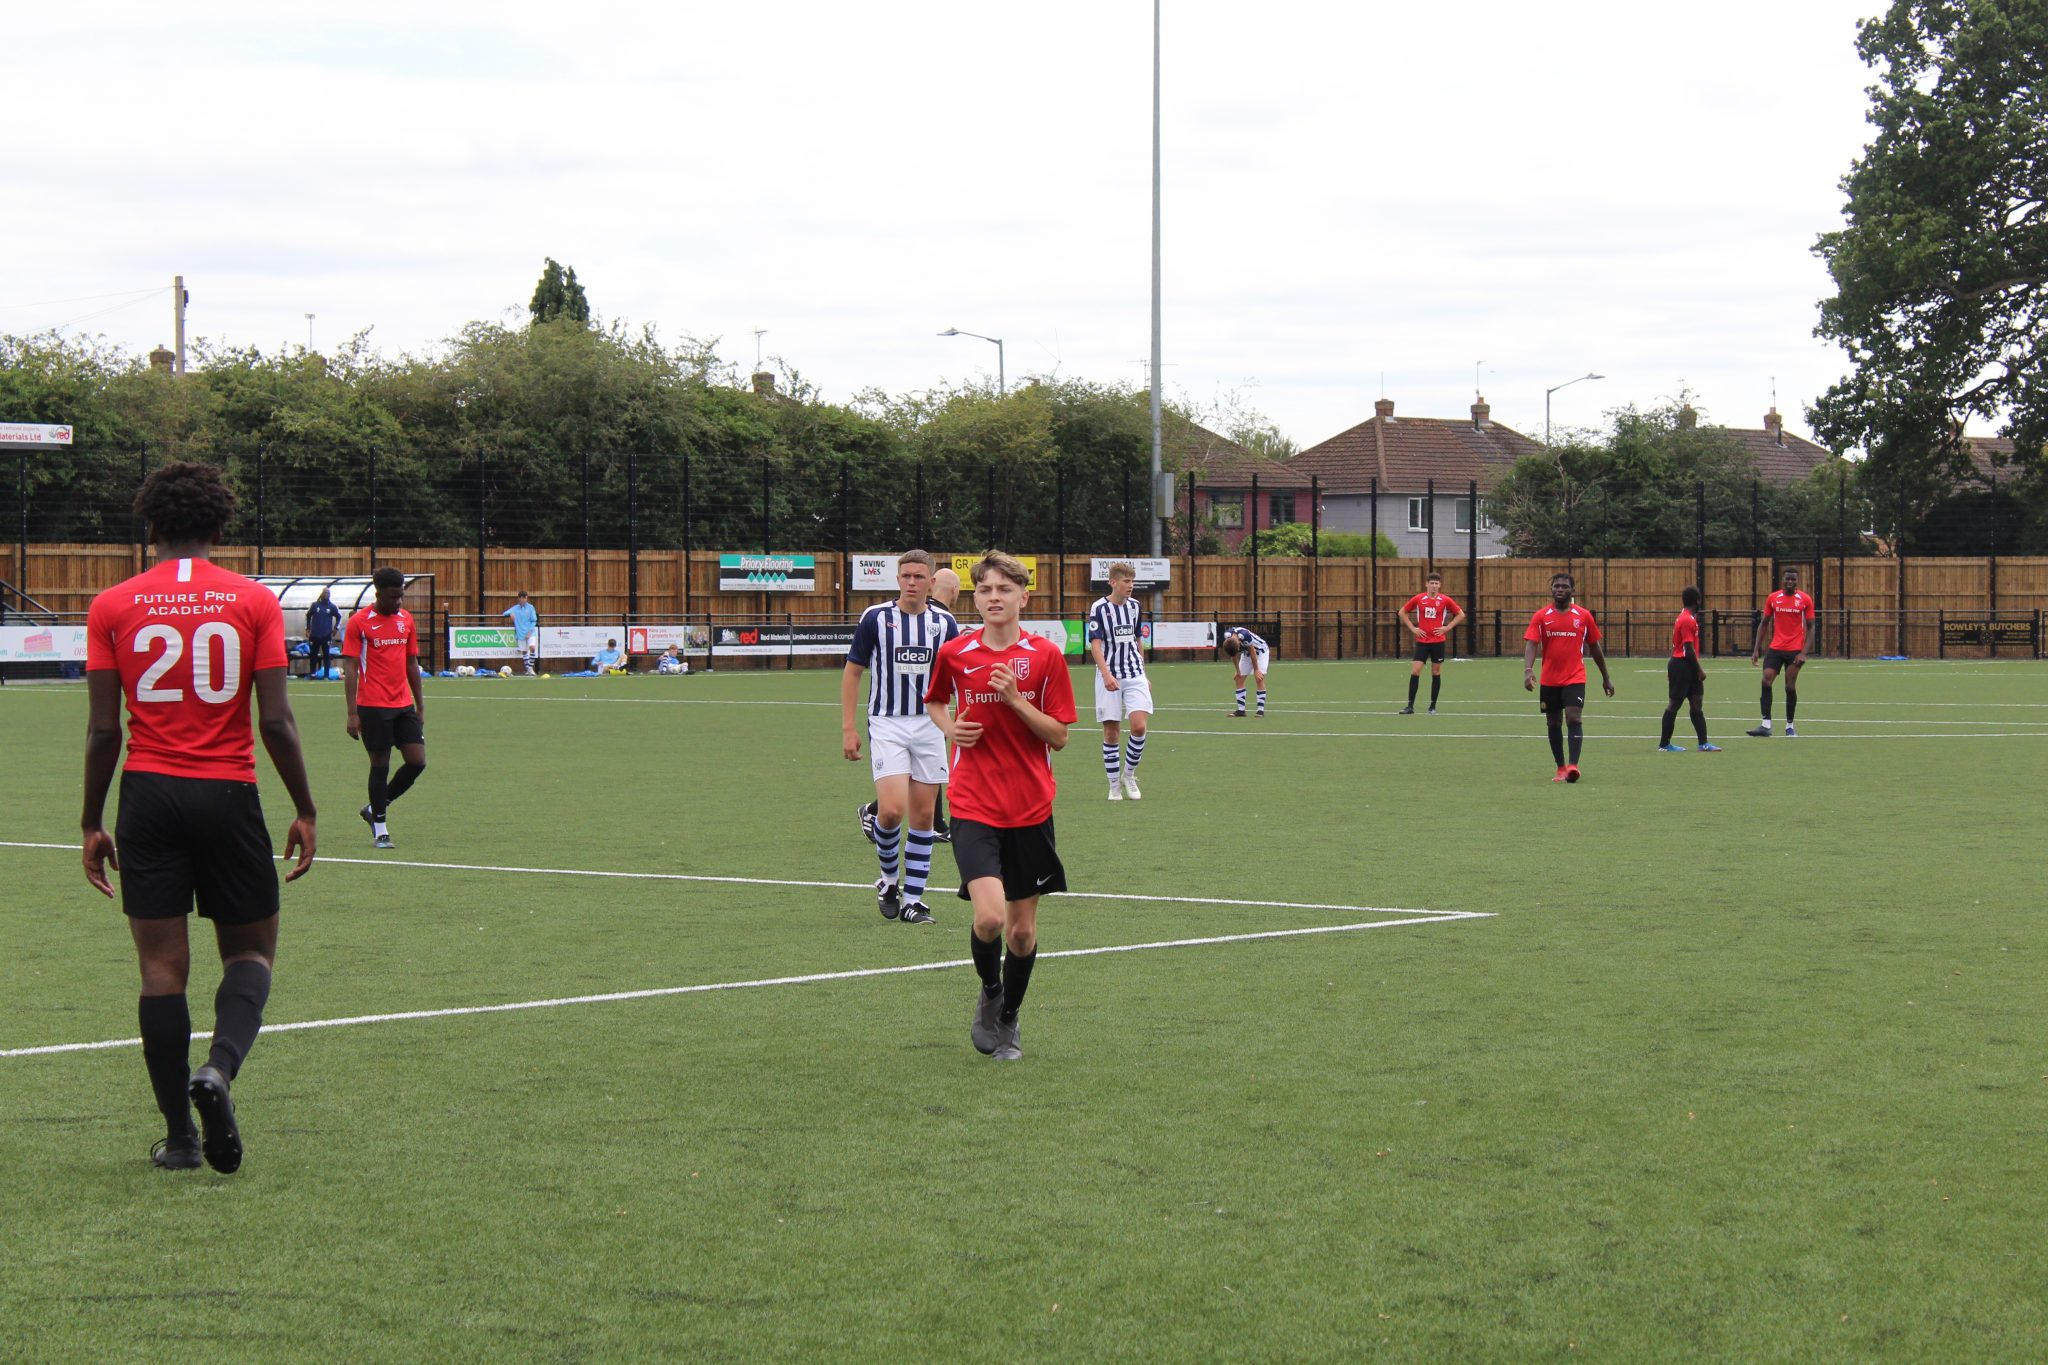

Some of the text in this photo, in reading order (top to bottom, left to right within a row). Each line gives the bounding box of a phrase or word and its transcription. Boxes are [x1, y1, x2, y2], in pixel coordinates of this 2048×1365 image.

[741, 557, 793, 572] Priory Flooring
[859, 560, 886, 568] SAVING
[955, 559, 969, 570] GR
[863, 568, 881, 576] LIVES
[134, 593, 198, 605] FUTURE
[147, 604, 225, 616] ACADEMY
[1115, 625, 1133, 635] ideal
[1944, 623, 2031, 631] ROWLEY'S BUTCHERS
[457, 634, 468, 644] KS
[739, 627, 758, 644] red
[381, 638, 400, 646] FUTURE
[897, 649, 929, 662] ideal
[133, 621, 240, 704] 20
[975, 692, 1003, 703] FUTU
